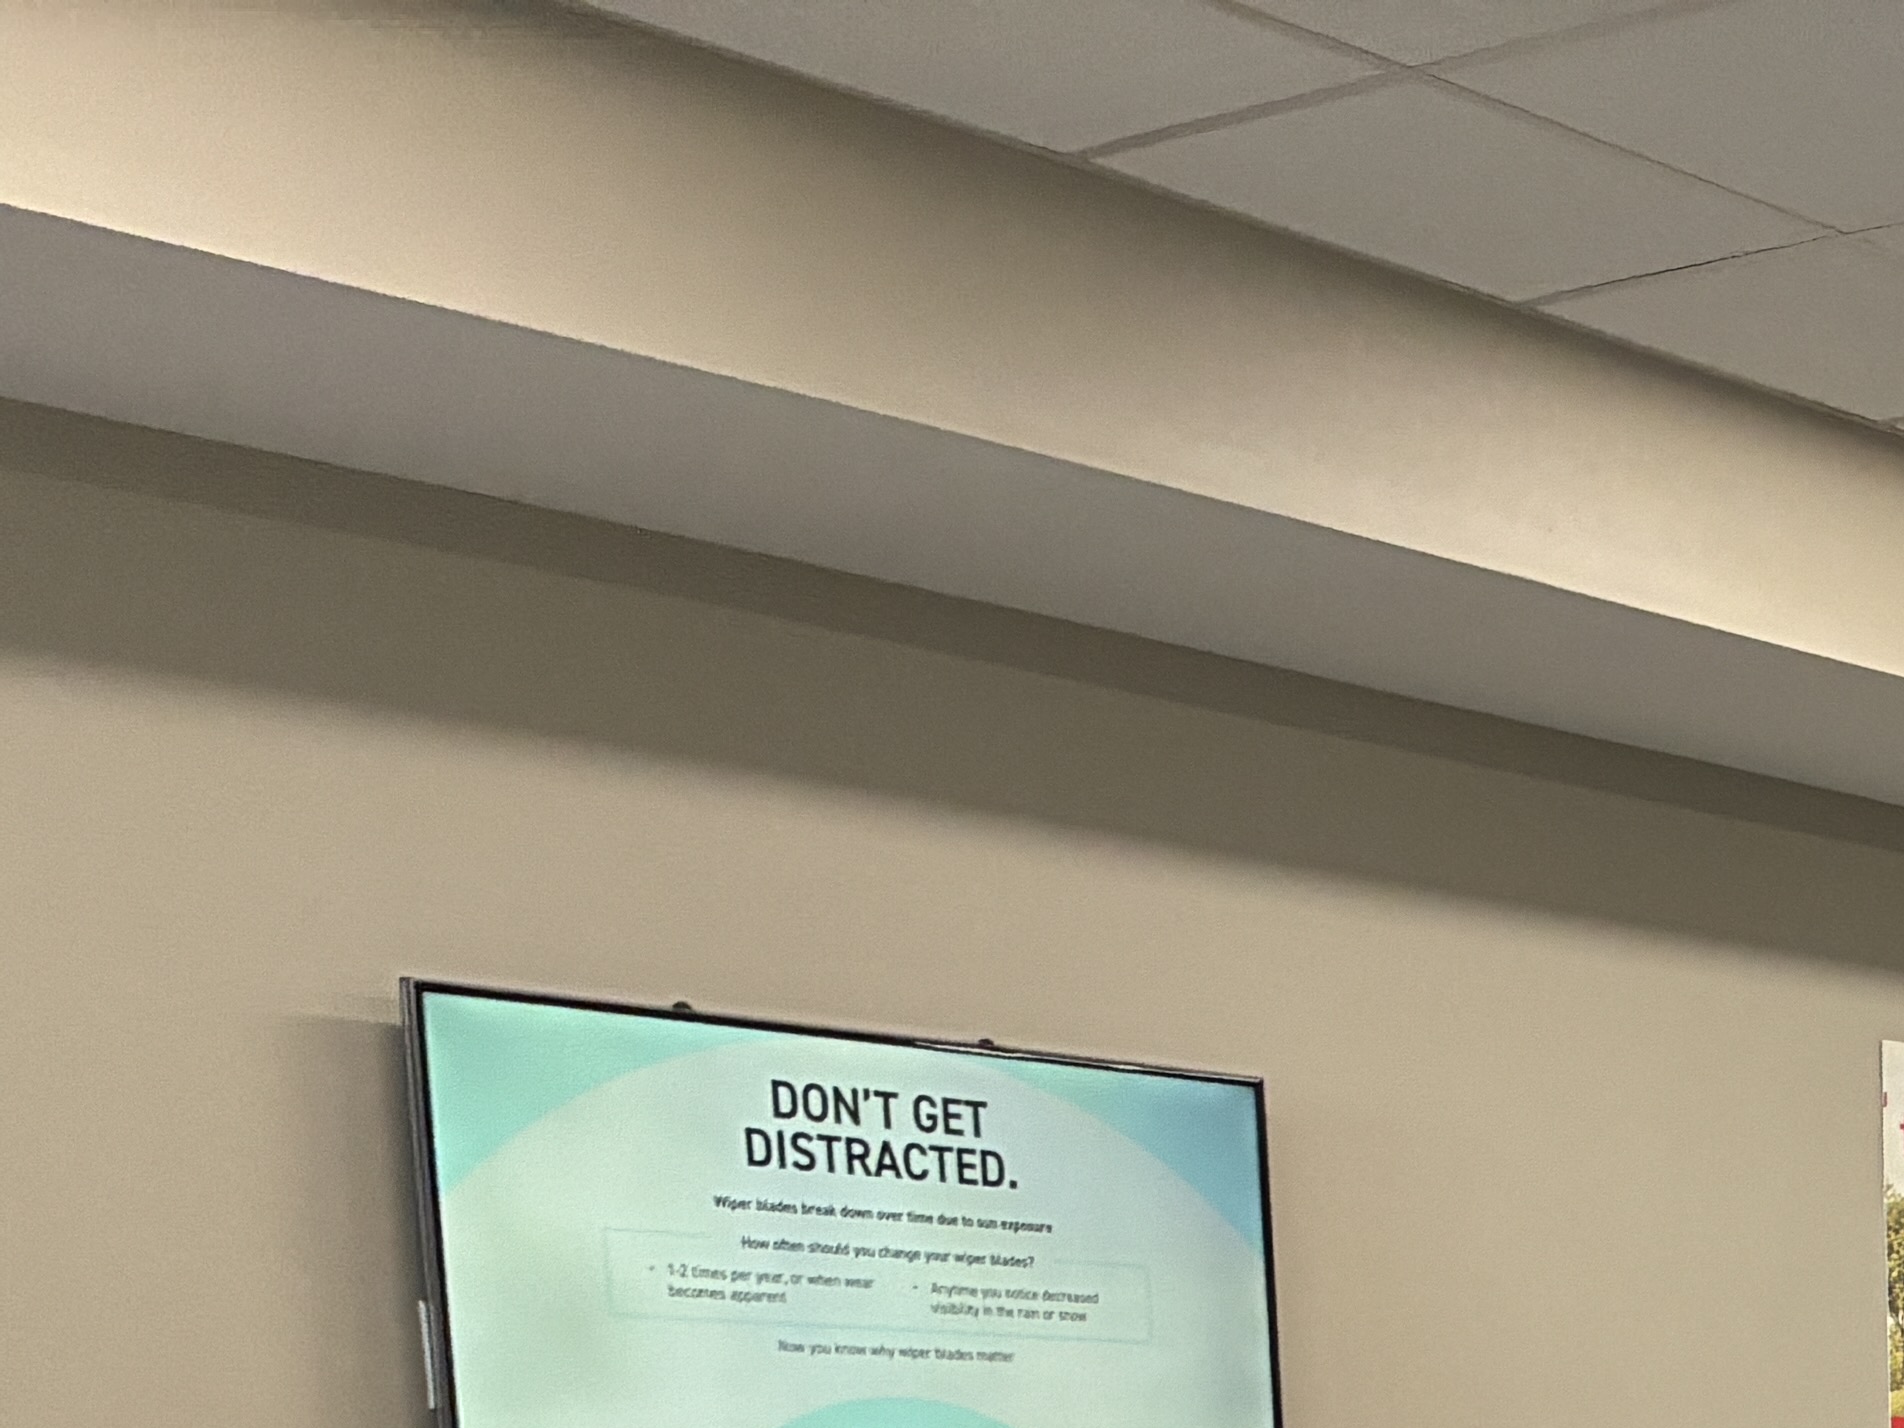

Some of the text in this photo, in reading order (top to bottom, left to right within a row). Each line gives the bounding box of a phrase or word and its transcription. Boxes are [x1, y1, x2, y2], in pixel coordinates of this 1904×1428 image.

[771, 1079, 988, 1138] DON'T GET
[745, 1127, 1018, 1189] DISTRACTED.
[714, 1195, 752, 1211] Wiper
[756, 1197, 798, 1214] blades
[801, 1202, 837, 1217] break
[840, 1204, 873, 1220] down
[876, 1210, 903, 1222] over
[906, 1211, 933, 1224] time
[937, 1213, 958, 1227] due
[962, 1215, 974, 1227] to
[741, 1236, 770, 1250] How
[773, 1238, 805, 1252] often
[807, 1241, 850, 1256] should
[853, 1247, 876, 1259] you
[878, 1247, 921, 1263] change
[924, 1250, 950, 1264] your
[691, 1264, 728, 1281] times
[730, 1271, 753, 1283] per
[790, 1273, 804, 1284] or
[807, 1274, 841, 1287] when
[981, 1287, 1002, 1300] you
[983, 1305, 993, 1316] in
[996, 1305, 1014, 1318] the
[1043, 1309, 1055, 1320] or
[807, 1342, 832, 1356] you
[870, 1344, 895, 1360] why
[935, 1347, 973, 1361] blades
